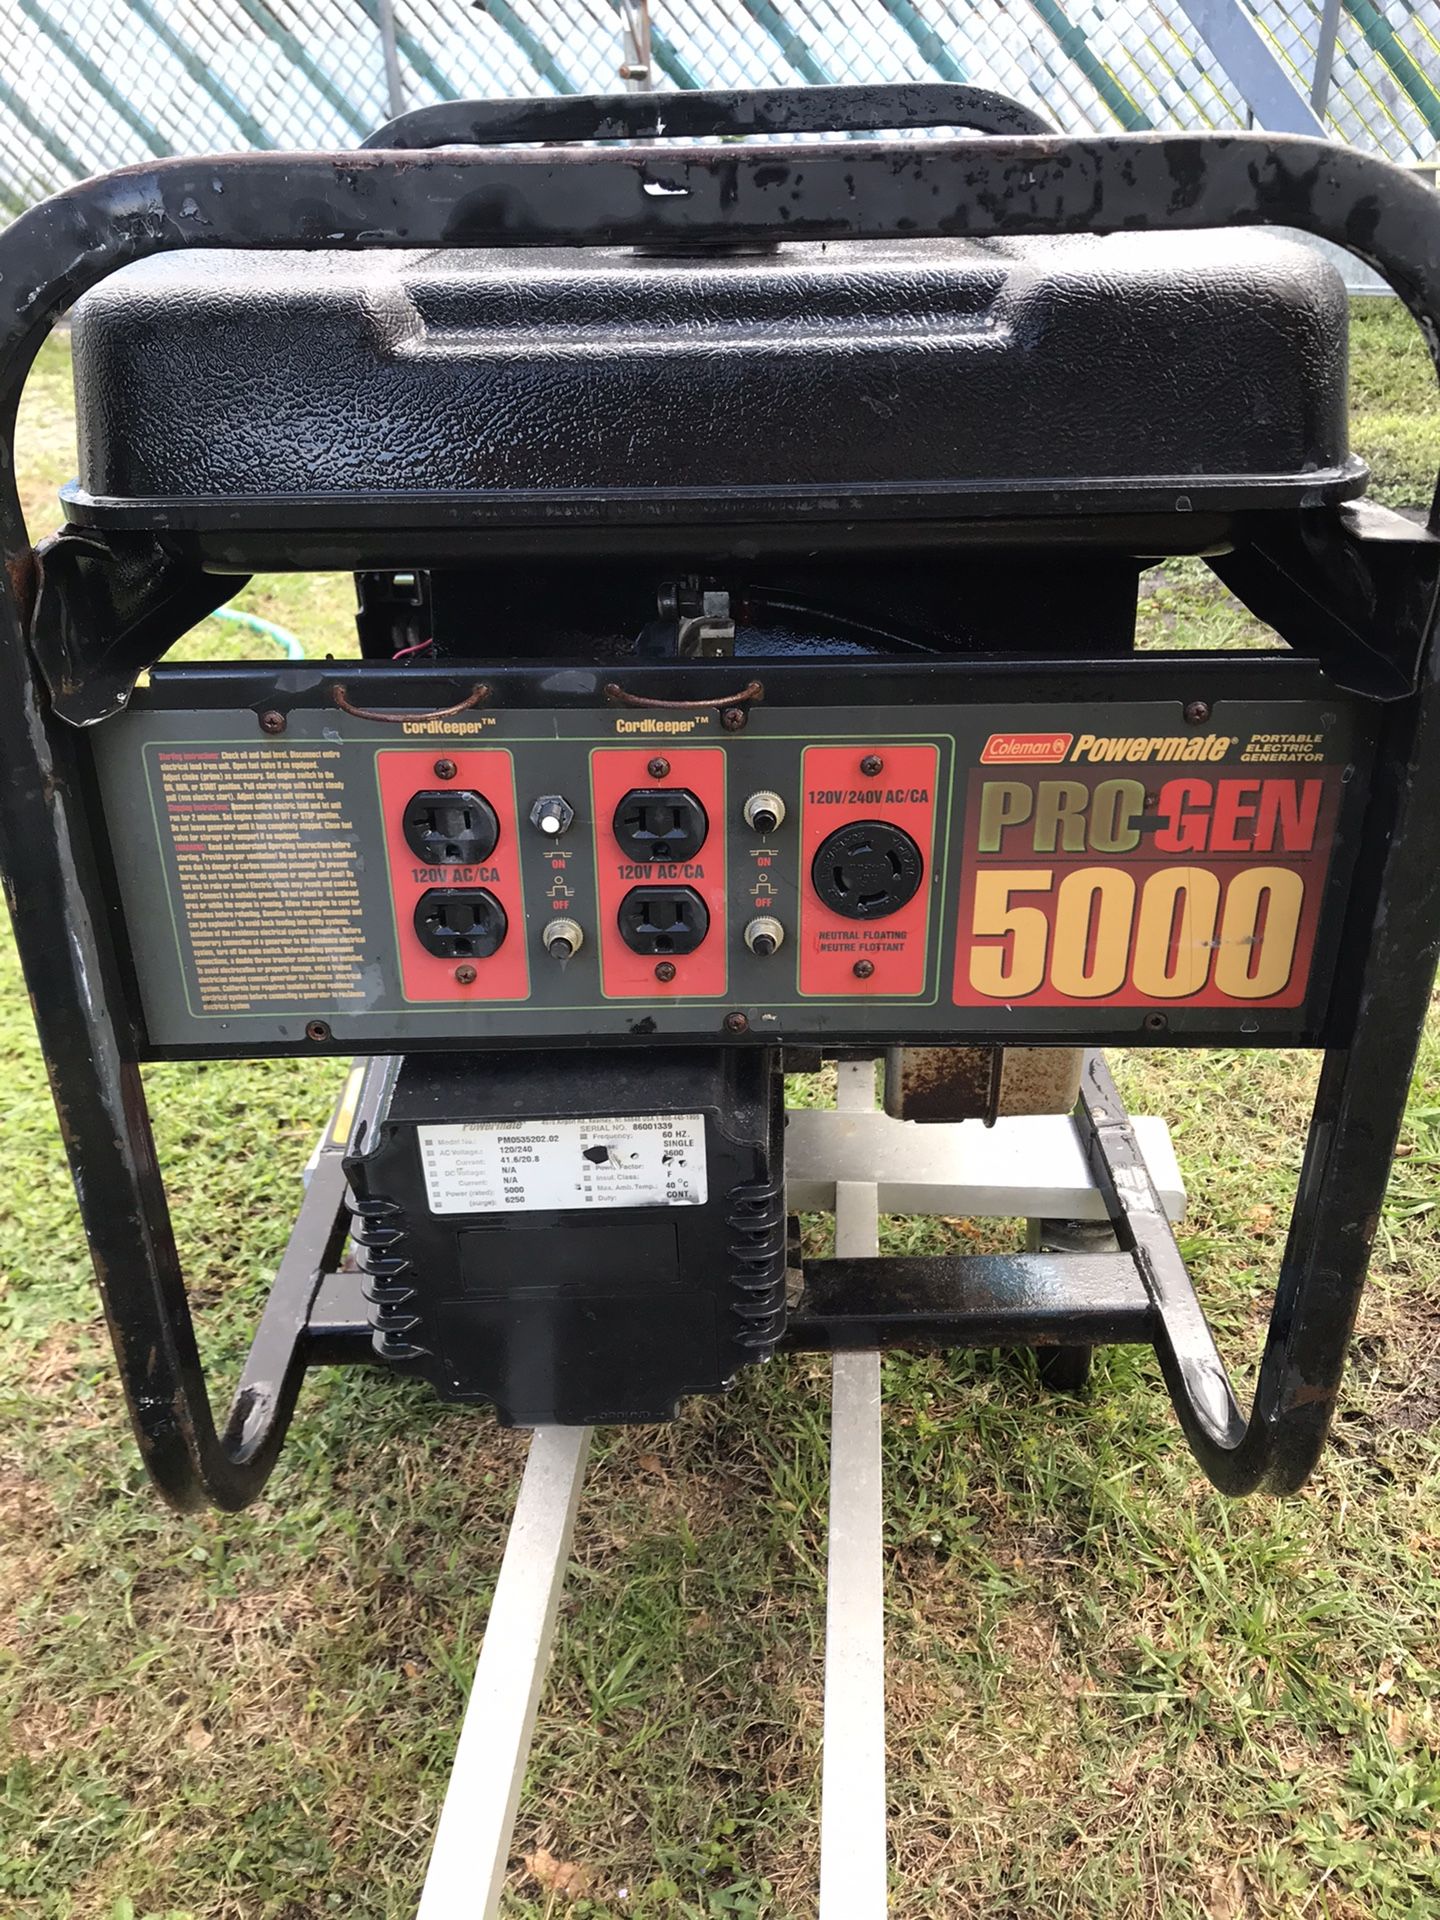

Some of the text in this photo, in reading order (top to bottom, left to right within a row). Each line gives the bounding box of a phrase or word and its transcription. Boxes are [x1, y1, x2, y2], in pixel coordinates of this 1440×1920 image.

[1250, 734, 1323, 743] PORTABLE
[990, 739, 1050, 756] Coleman
[1246, 744, 1313, 753] ELECTRIC
[1240, 753, 1324, 762] GENERATOR
[808, 789, 929, 804] 120V/240V AC/CA
[977, 778, 1323, 853] PRO-GEN
[552, 859, 566, 869] ON
[757, 857, 772, 866] ON
[411, 867, 501, 883] 120V AC/CA
[617, 864, 705, 880] 120V AC/CA
[553, 900, 569, 909] OFF
[755, 898, 772, 907] OFF
[819, 931, 907, 940] NEUTRAL FLOATING
[968, 866, 1305, 999] 5000
[820, 943, 905, 951] NEUTRE FLOTTANT
[632, 1122, 673, 1131] 86001339
[676, 1130, 691, 1138] HZ.
[497, 1135, 560, 1144] PM0535202.02
[664, 1139, 694, 1147] SINGLE
[500, 1146, 533, 1154] 120/240
[504, 1186, 525, 1194] 5000
[666, 1191, 693, 1199] CONT.
[505, 1196, 525, 1204] 6250
